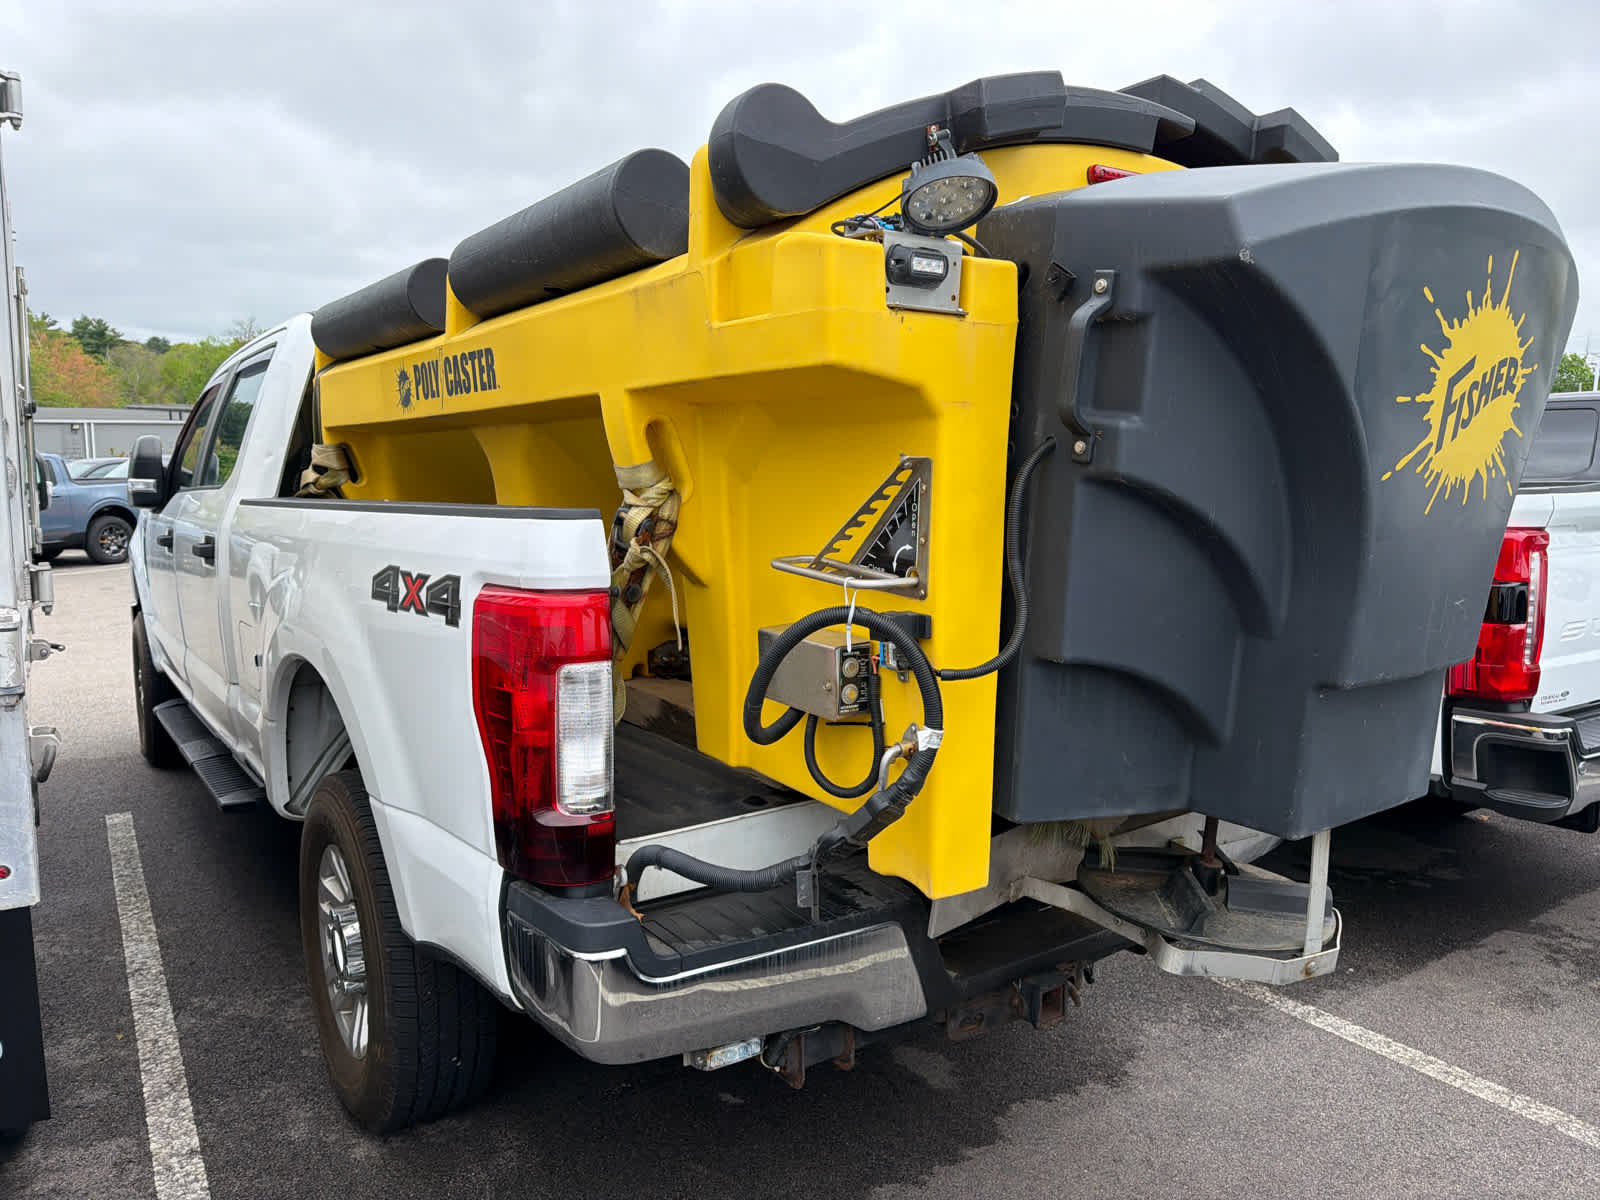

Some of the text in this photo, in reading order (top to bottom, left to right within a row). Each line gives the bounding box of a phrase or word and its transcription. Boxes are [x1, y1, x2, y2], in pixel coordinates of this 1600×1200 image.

[413, 360, 440, 400] POLY
[444, 347, 497, 397] CASTER
[1434, 355, 1518, 454] FISHER
